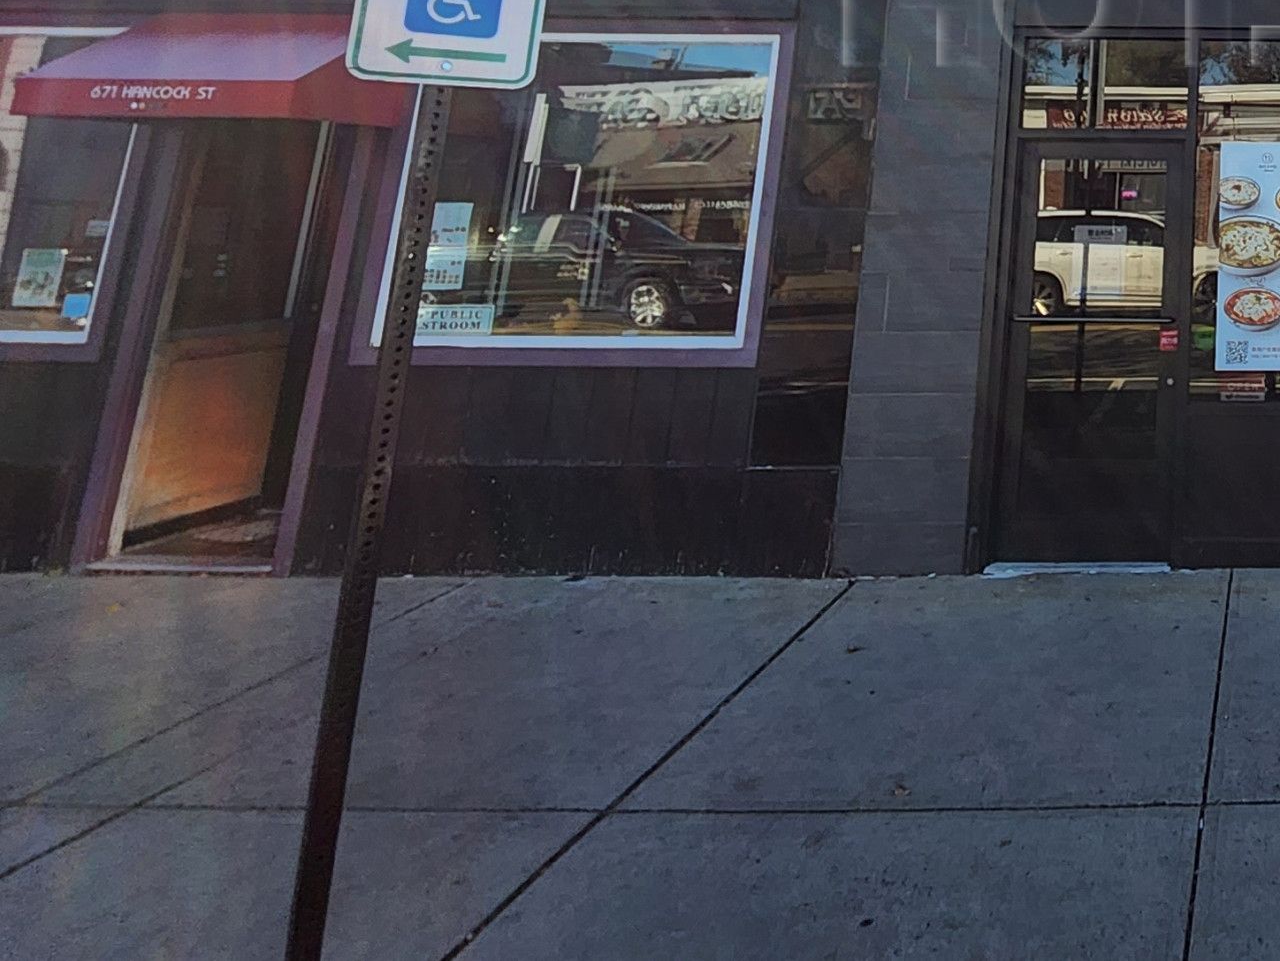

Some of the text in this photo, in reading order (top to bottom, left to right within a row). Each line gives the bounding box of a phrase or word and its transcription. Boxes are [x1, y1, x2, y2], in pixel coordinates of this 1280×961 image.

[90, 85, 216, 101] 671 HANCOCK ST
[430, 310, 483, 320] PUBLIC
[421, 321, 481, 331] STROOM
